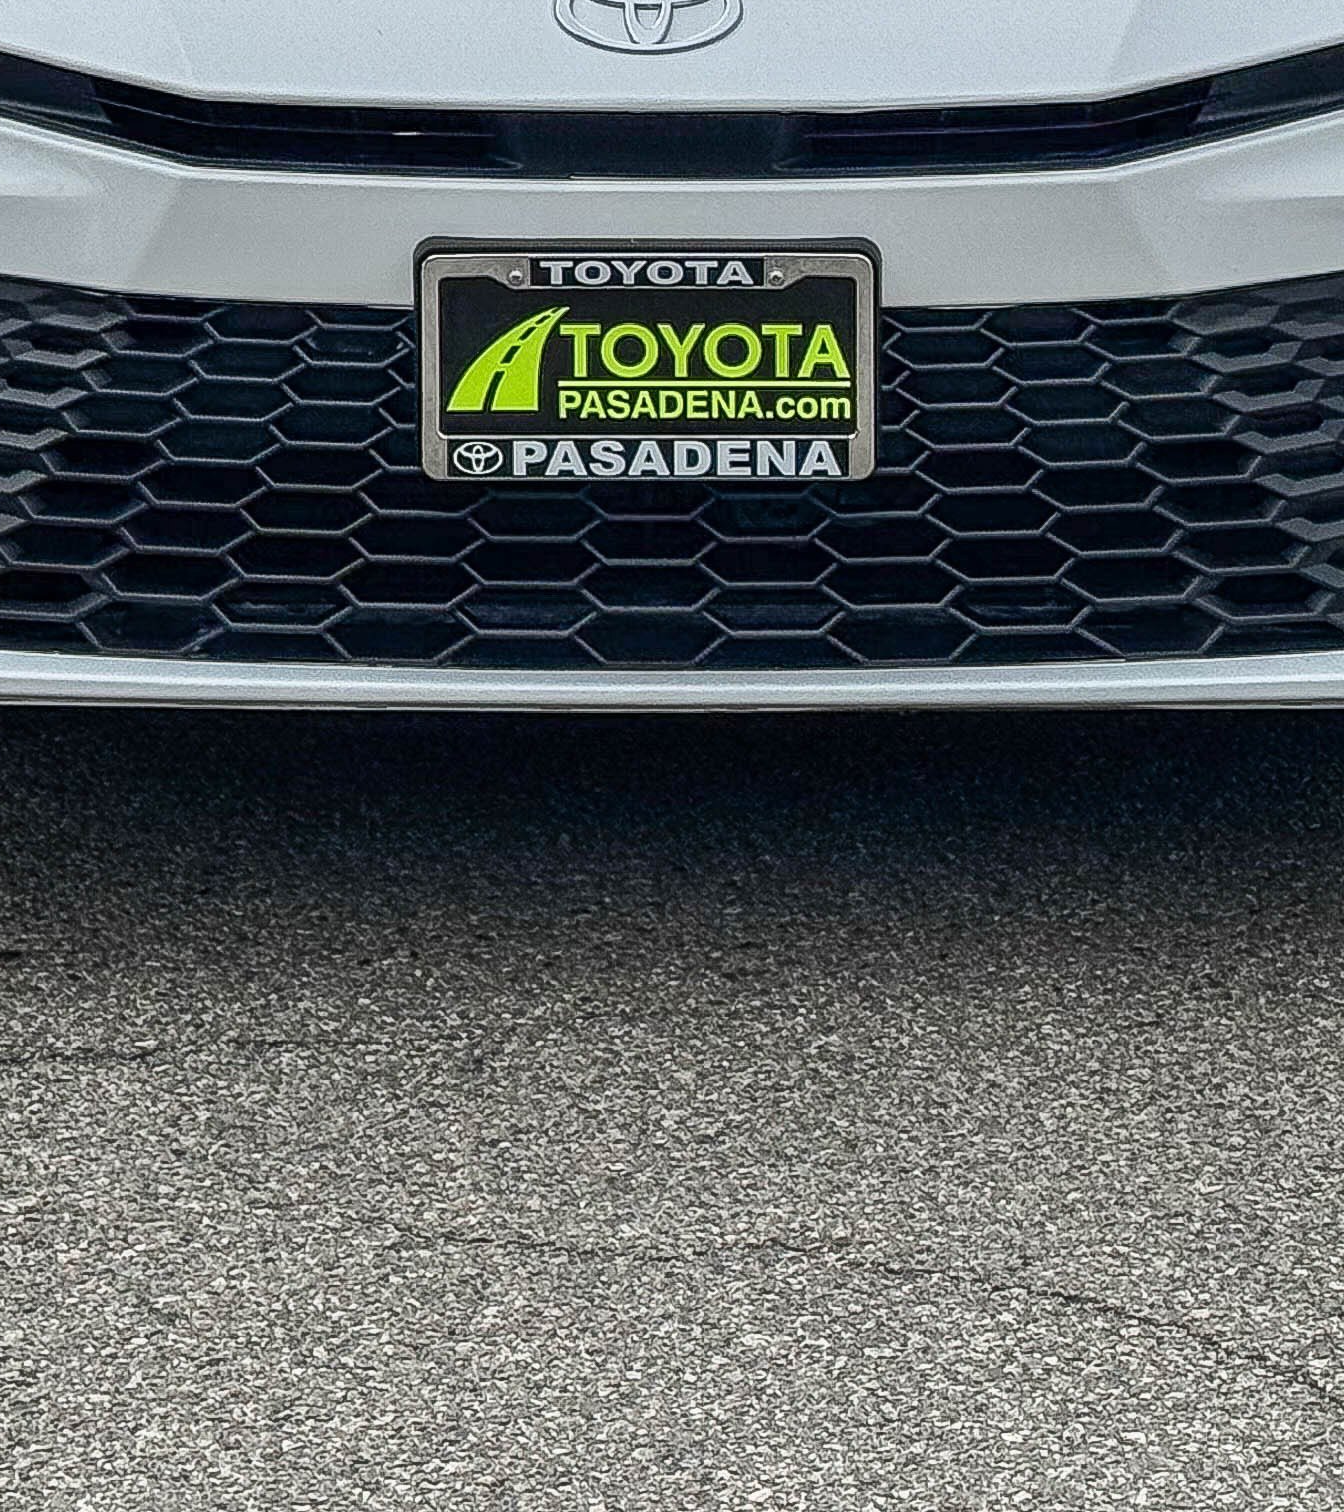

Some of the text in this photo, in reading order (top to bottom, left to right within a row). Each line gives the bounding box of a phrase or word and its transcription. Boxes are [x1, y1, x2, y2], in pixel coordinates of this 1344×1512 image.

[539, 260, 754, 286] TOYOTA
[558, 323, 852, 378] TOYOTA
[558, 390, 852, 420] PASADENA.com
[512, 440, 842, 477] PASADENA
